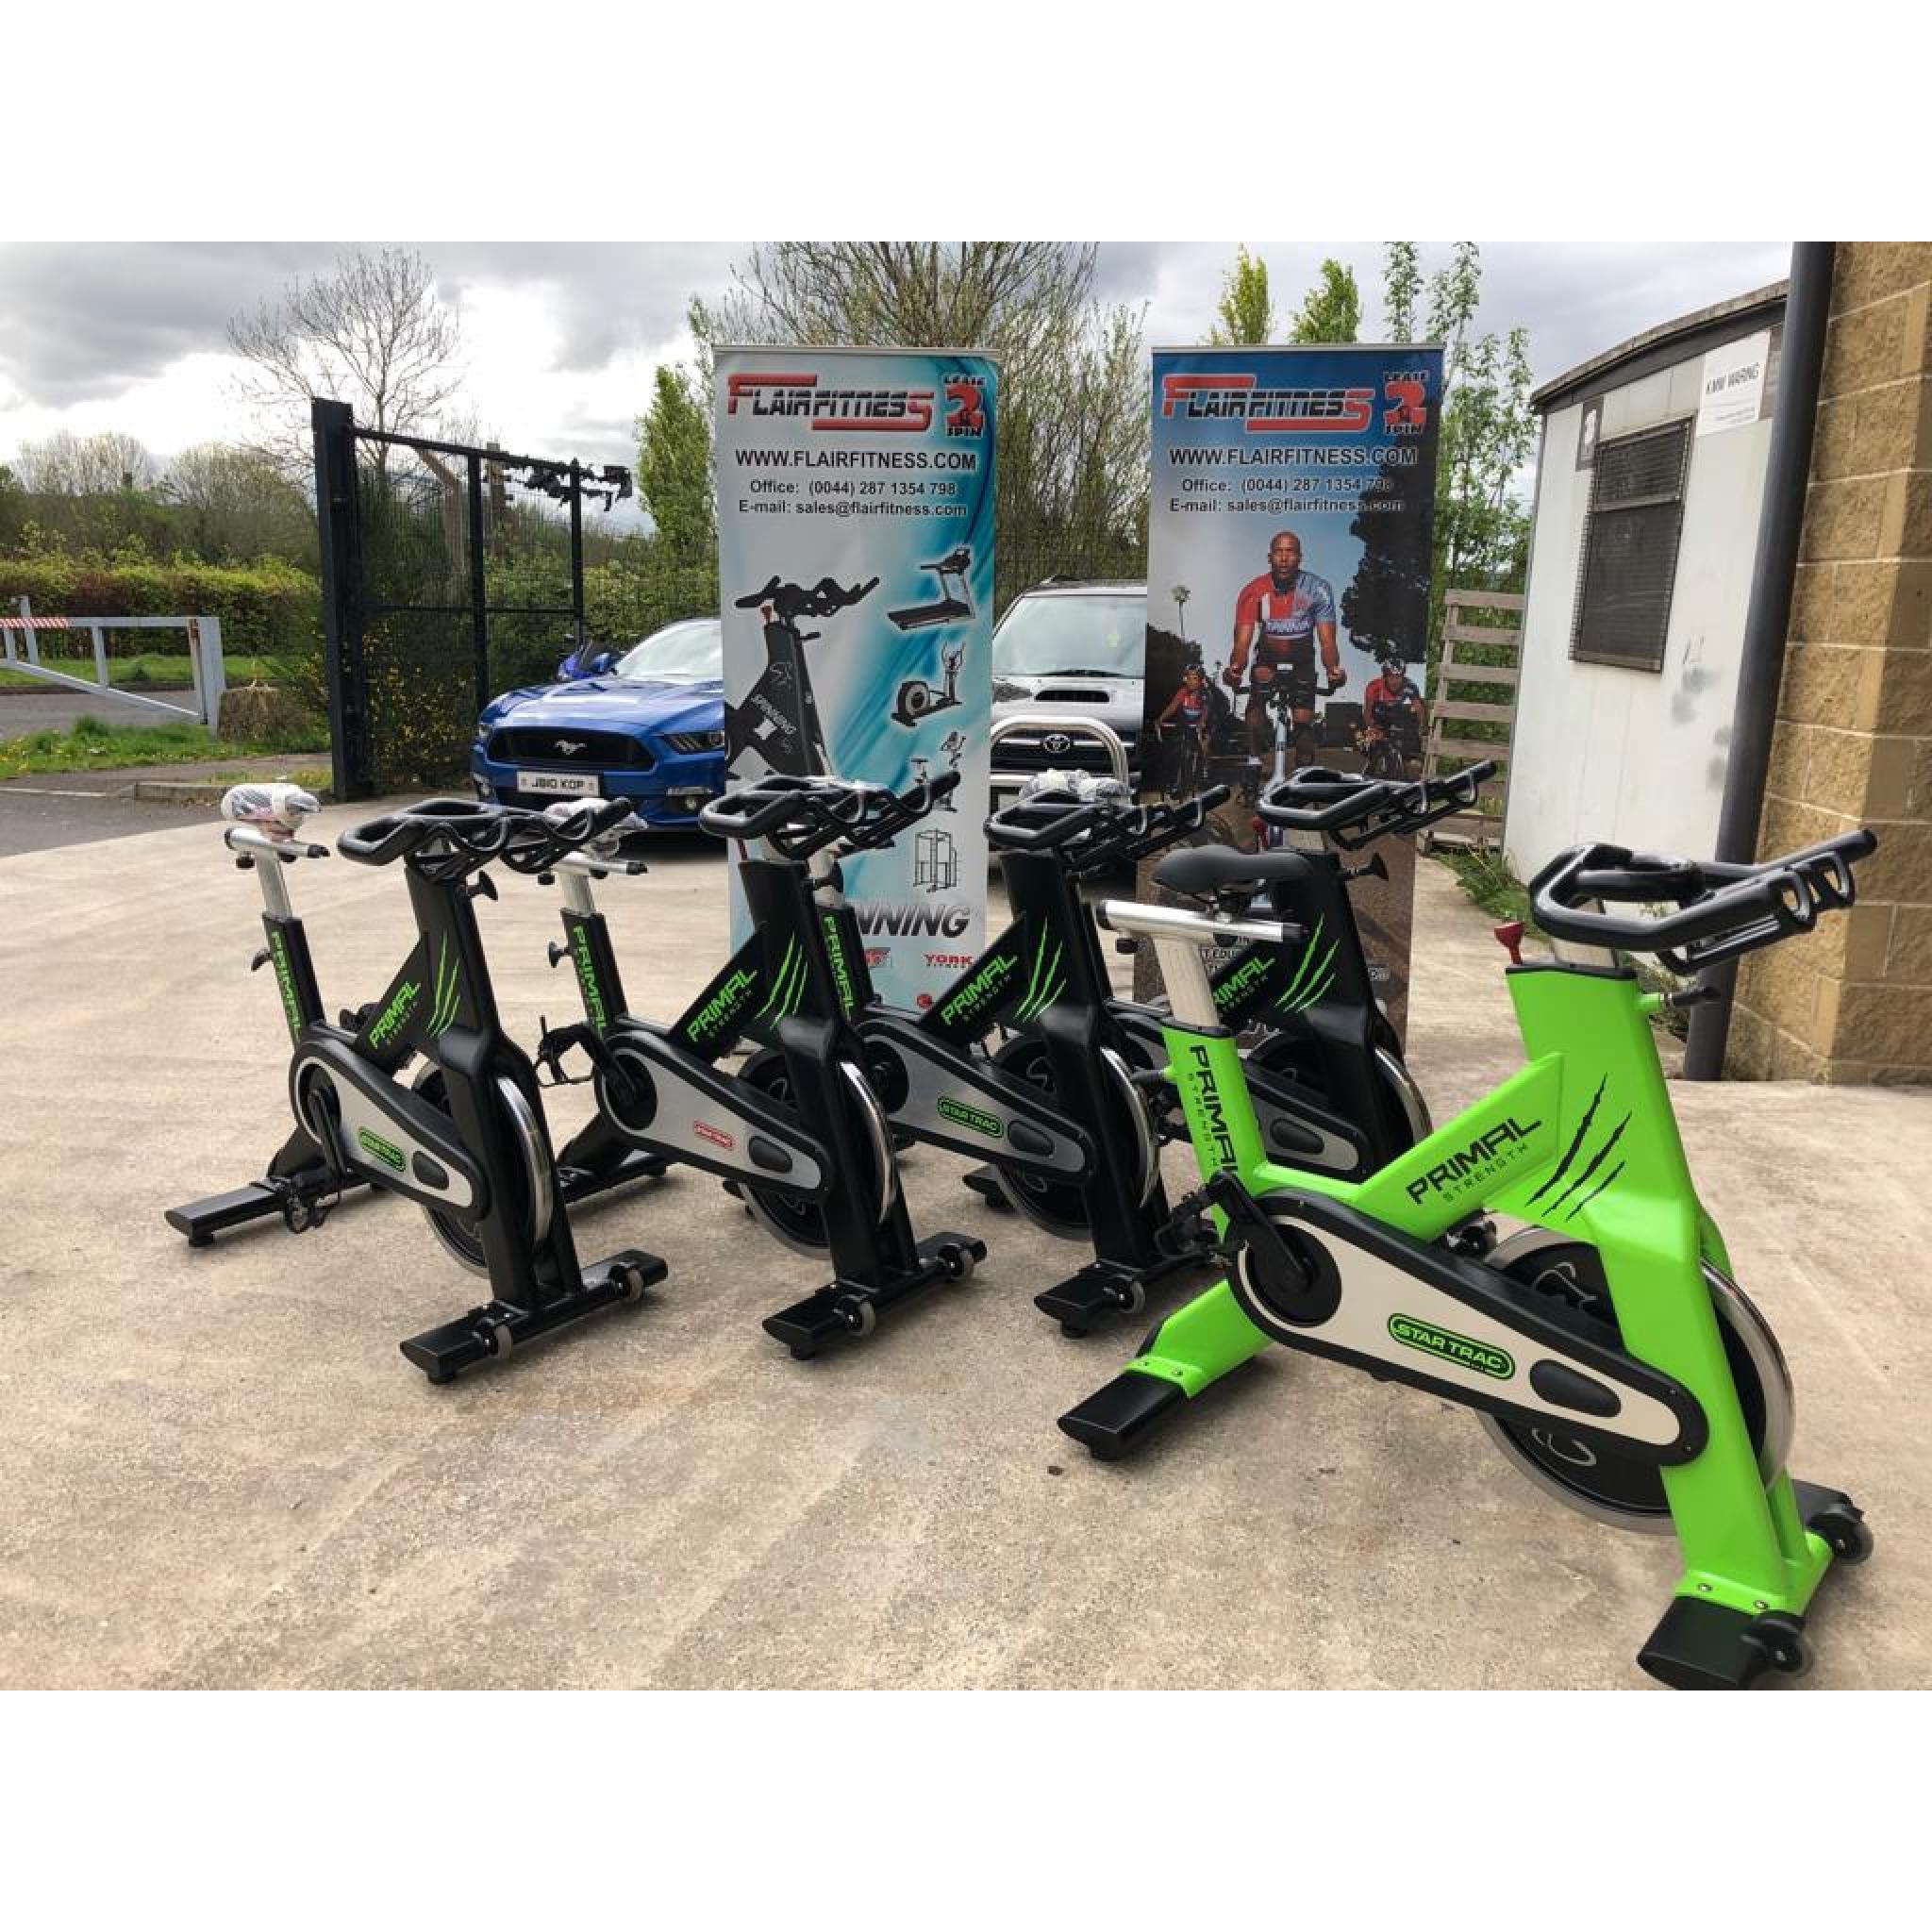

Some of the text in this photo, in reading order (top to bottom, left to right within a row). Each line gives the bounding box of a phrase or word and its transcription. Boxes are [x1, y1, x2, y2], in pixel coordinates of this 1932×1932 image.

[735, 449, 976, 470] WWW.FLAIRFITNESS.COM
[1169, 447, 1418, 466] WWW.FLAIRFITNESS.COM
[750, 479, 956, 495] Office: (0044) 287 1354 798
[1182, 478, 1231, 492] Office:
[1241, 478, 1289, 494] (0044)
[1293, 478, 1319, 492] 287
[1325, 478, 1360, 492] 1354
[739, 499, 967, 517] E-mail: sales@flairfitness.com
[1169, 499, 1222, 513] E-mail:
[855, 904, 970, 939] NNING
[941, 954, 1018, 1025] PRIMAL
[1212, 956, 1275, 1005] RIMAL
[687, 969, 758, 1042] PRIMAL
[1405, 1117, 1541, 1205] PRIMAL
[1442, 1141, 1527, 1203] STRENGTH
[1395, 1323, 1503, 1369] STAR TRAC
